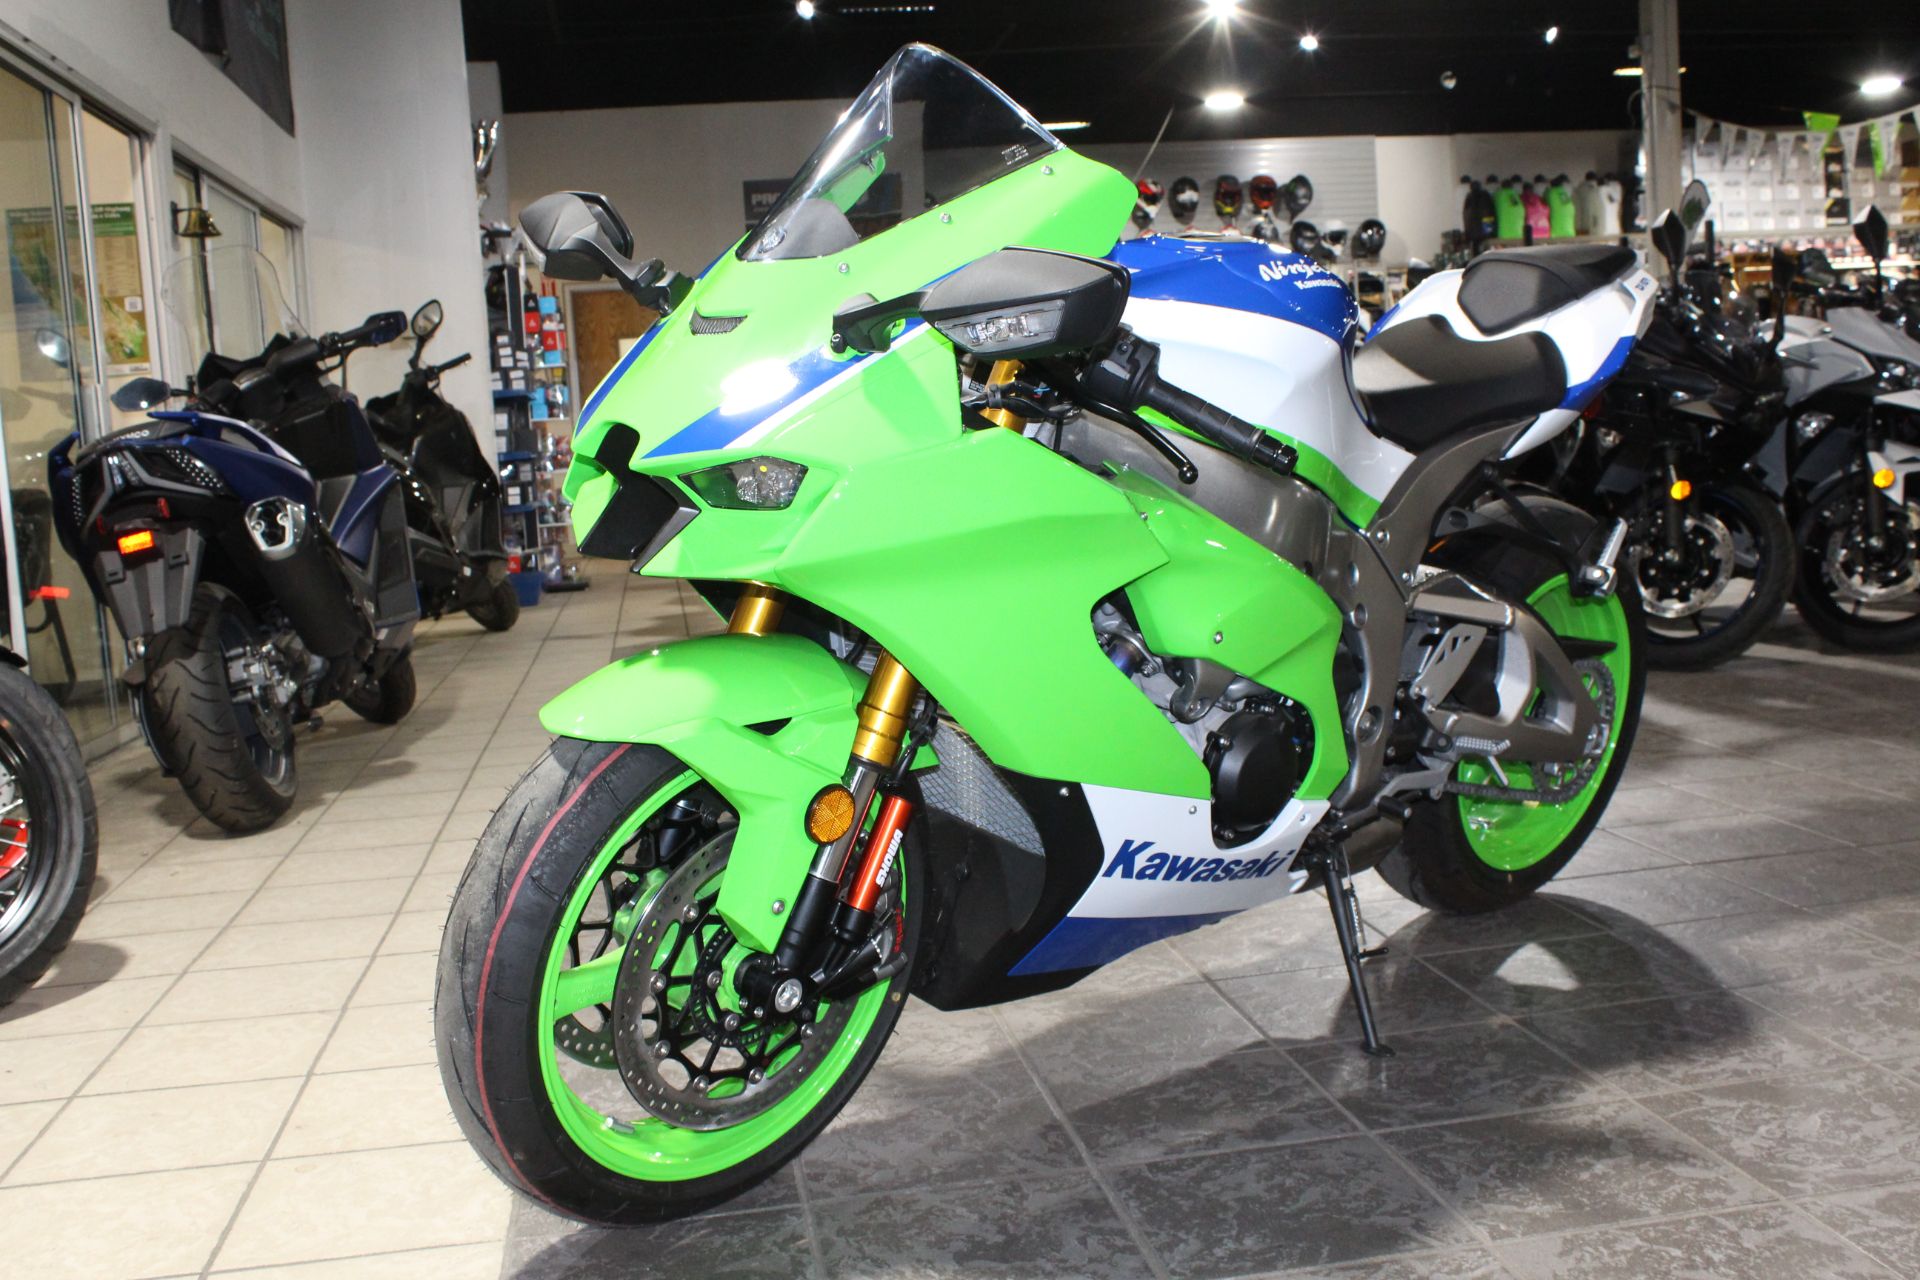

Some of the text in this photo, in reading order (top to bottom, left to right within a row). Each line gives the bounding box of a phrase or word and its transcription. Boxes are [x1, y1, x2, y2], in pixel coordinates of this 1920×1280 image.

[1259, 259, 1330, 281] Ninja
[876, 829, 903, 887] SHOWA
[1102, 839, 1297, 882] Kawasaki
